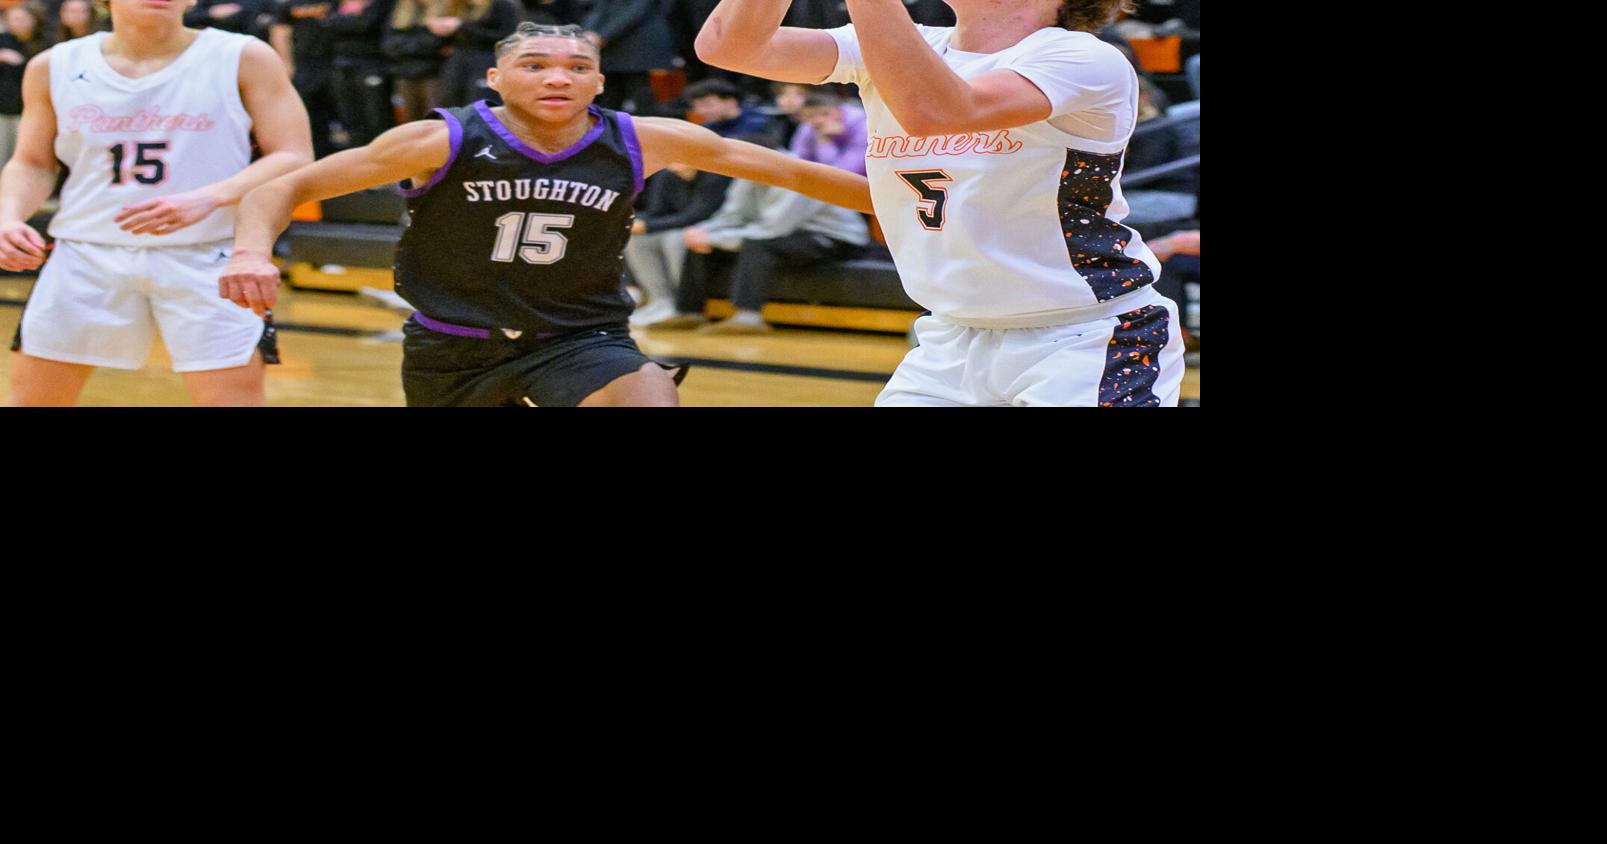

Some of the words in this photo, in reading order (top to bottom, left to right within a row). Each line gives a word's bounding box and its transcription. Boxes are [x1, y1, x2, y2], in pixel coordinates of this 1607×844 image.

[108, 140, 172, 188] 15
[462, 178, 621, 212] STOUGHTON
[894, 168, 953, 231] 5
[490, 211, 575, 265] 15
